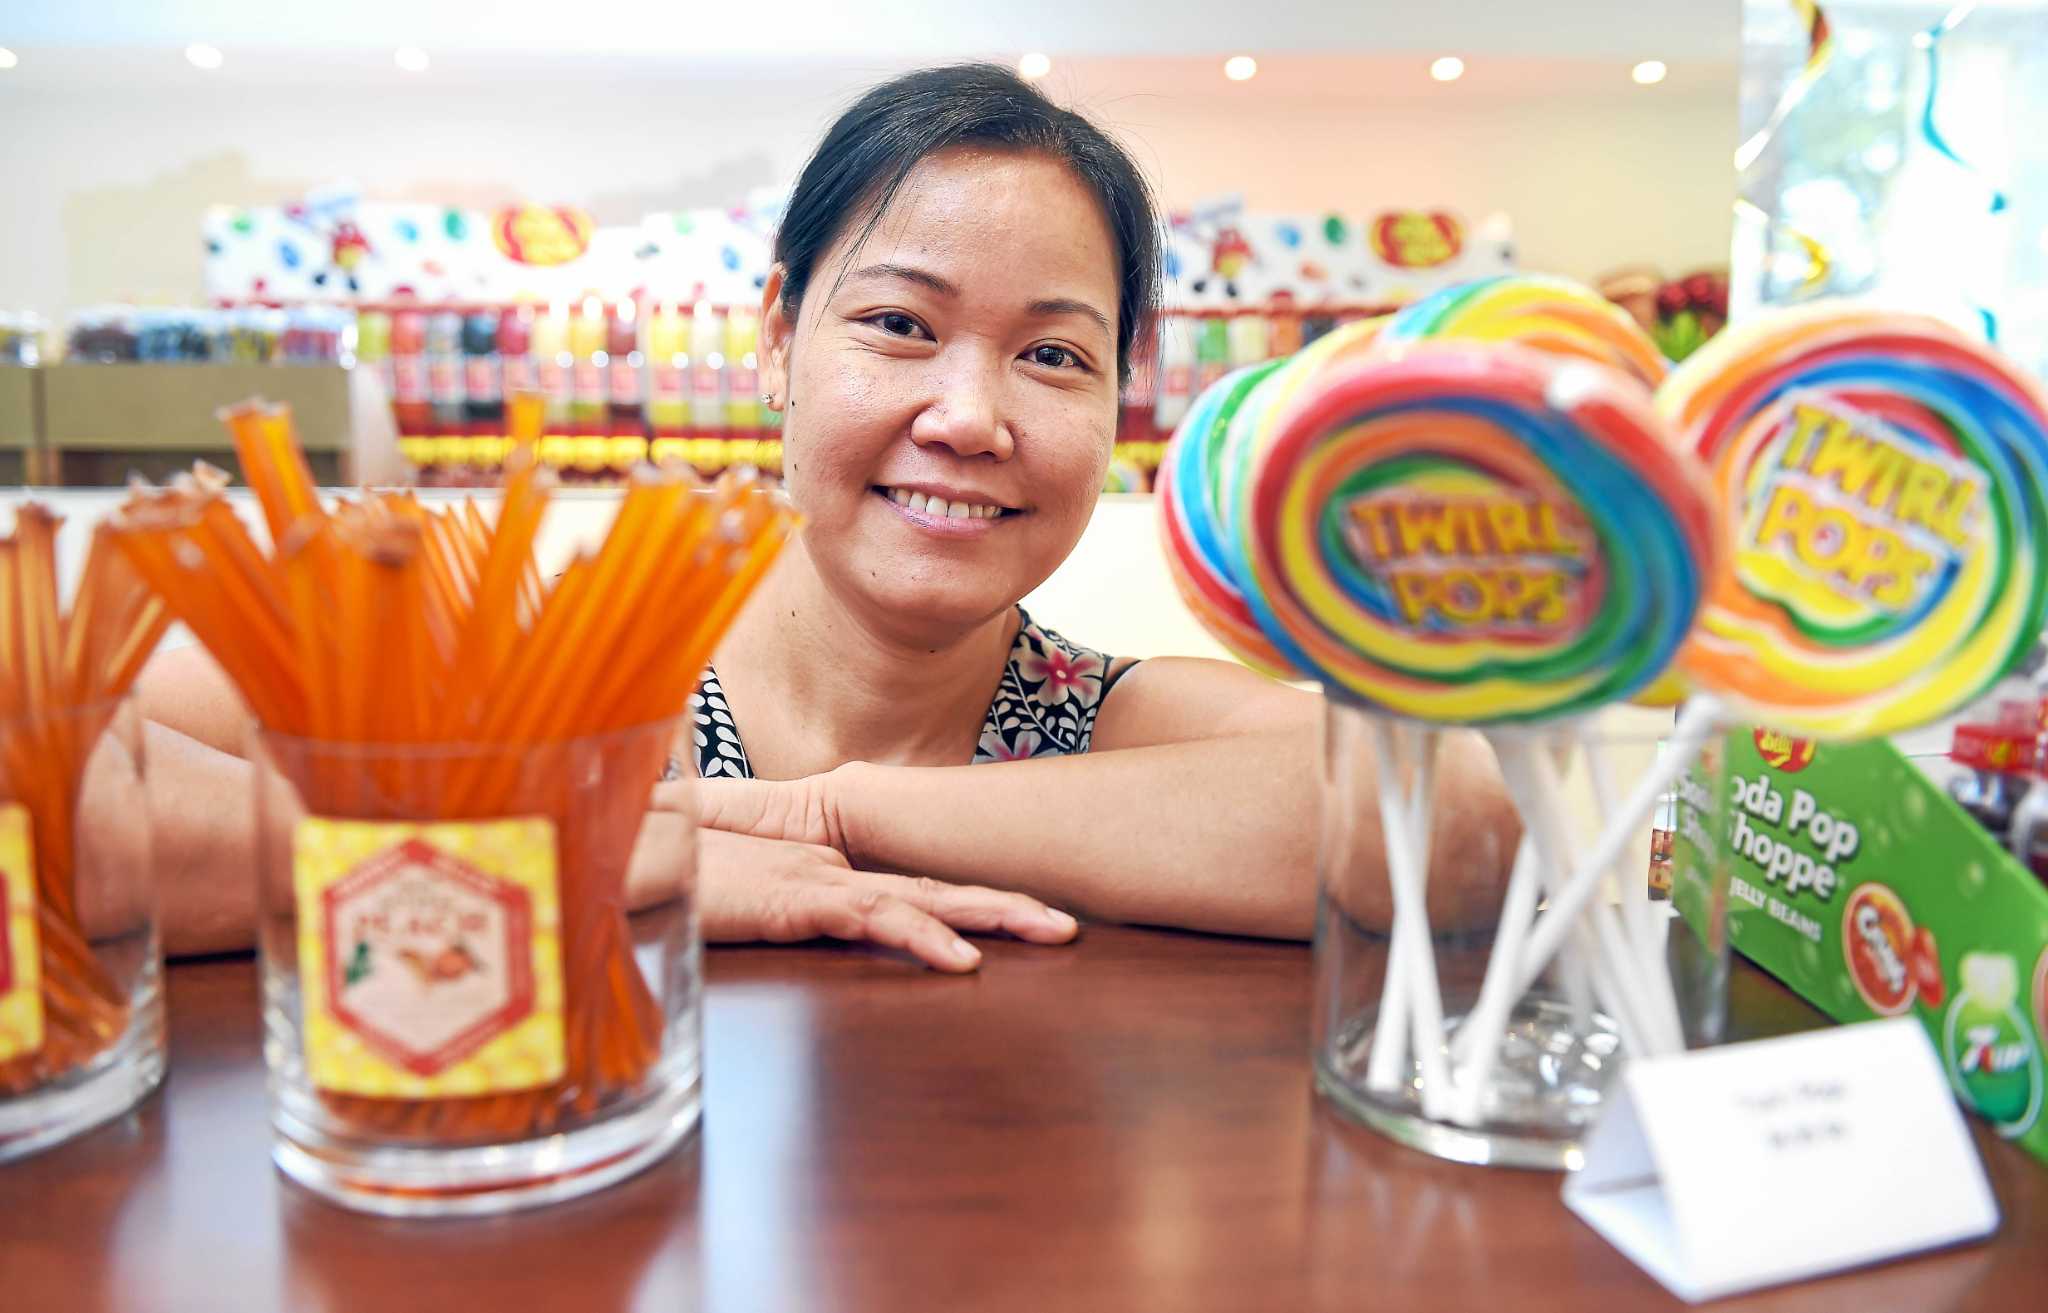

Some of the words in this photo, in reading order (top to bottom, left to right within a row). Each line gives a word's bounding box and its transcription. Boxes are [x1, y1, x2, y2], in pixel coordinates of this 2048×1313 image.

[1781, 402, 1978, 545] TWIRL
[1350, 500, 1580, 559] TWIRL
[1756, 485, 1934, 608] POPS
[1392, 568, 1569, 626] POPS
[1727, 807, 1837, 899] hoppe
[1788, 788, 1861, 864] Pop
[1728, 874, 1767, 911] JELLY
[1766, 896, 1823, 943] BEANS
